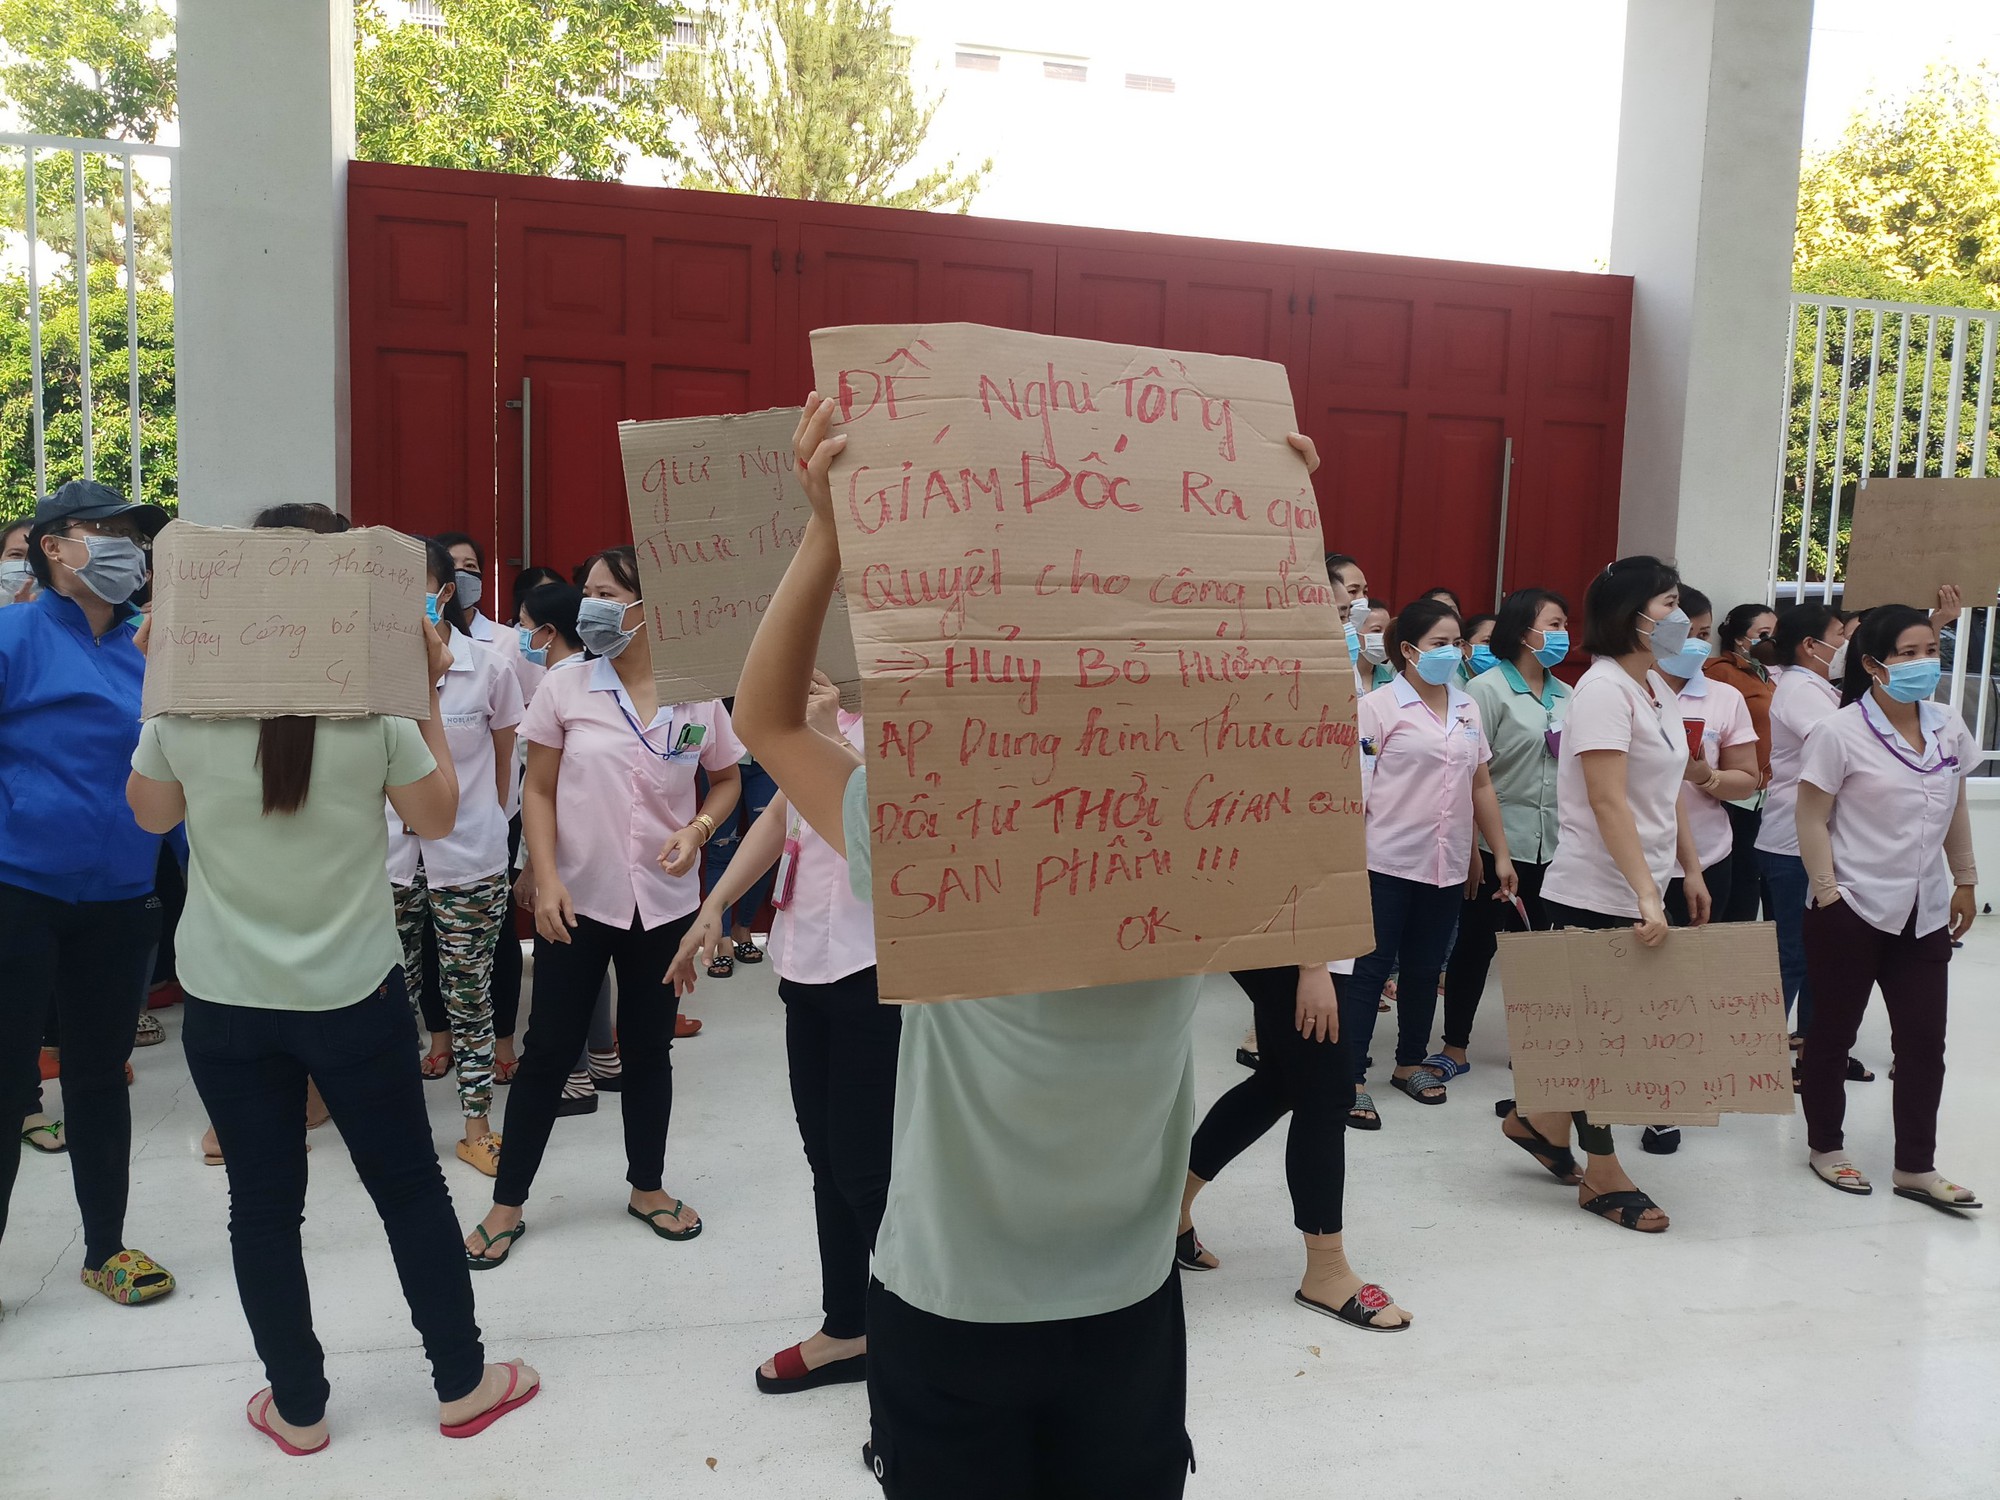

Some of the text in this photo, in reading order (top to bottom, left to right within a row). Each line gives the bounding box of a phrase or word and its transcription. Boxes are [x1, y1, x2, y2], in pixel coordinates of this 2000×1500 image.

[822, 340, 934, 427] ĐỀ
[738, 445, 796, 501] Ngu
[1181, 470, 1249, 521] Ra
[1035, 548, 1131, 596] cho
